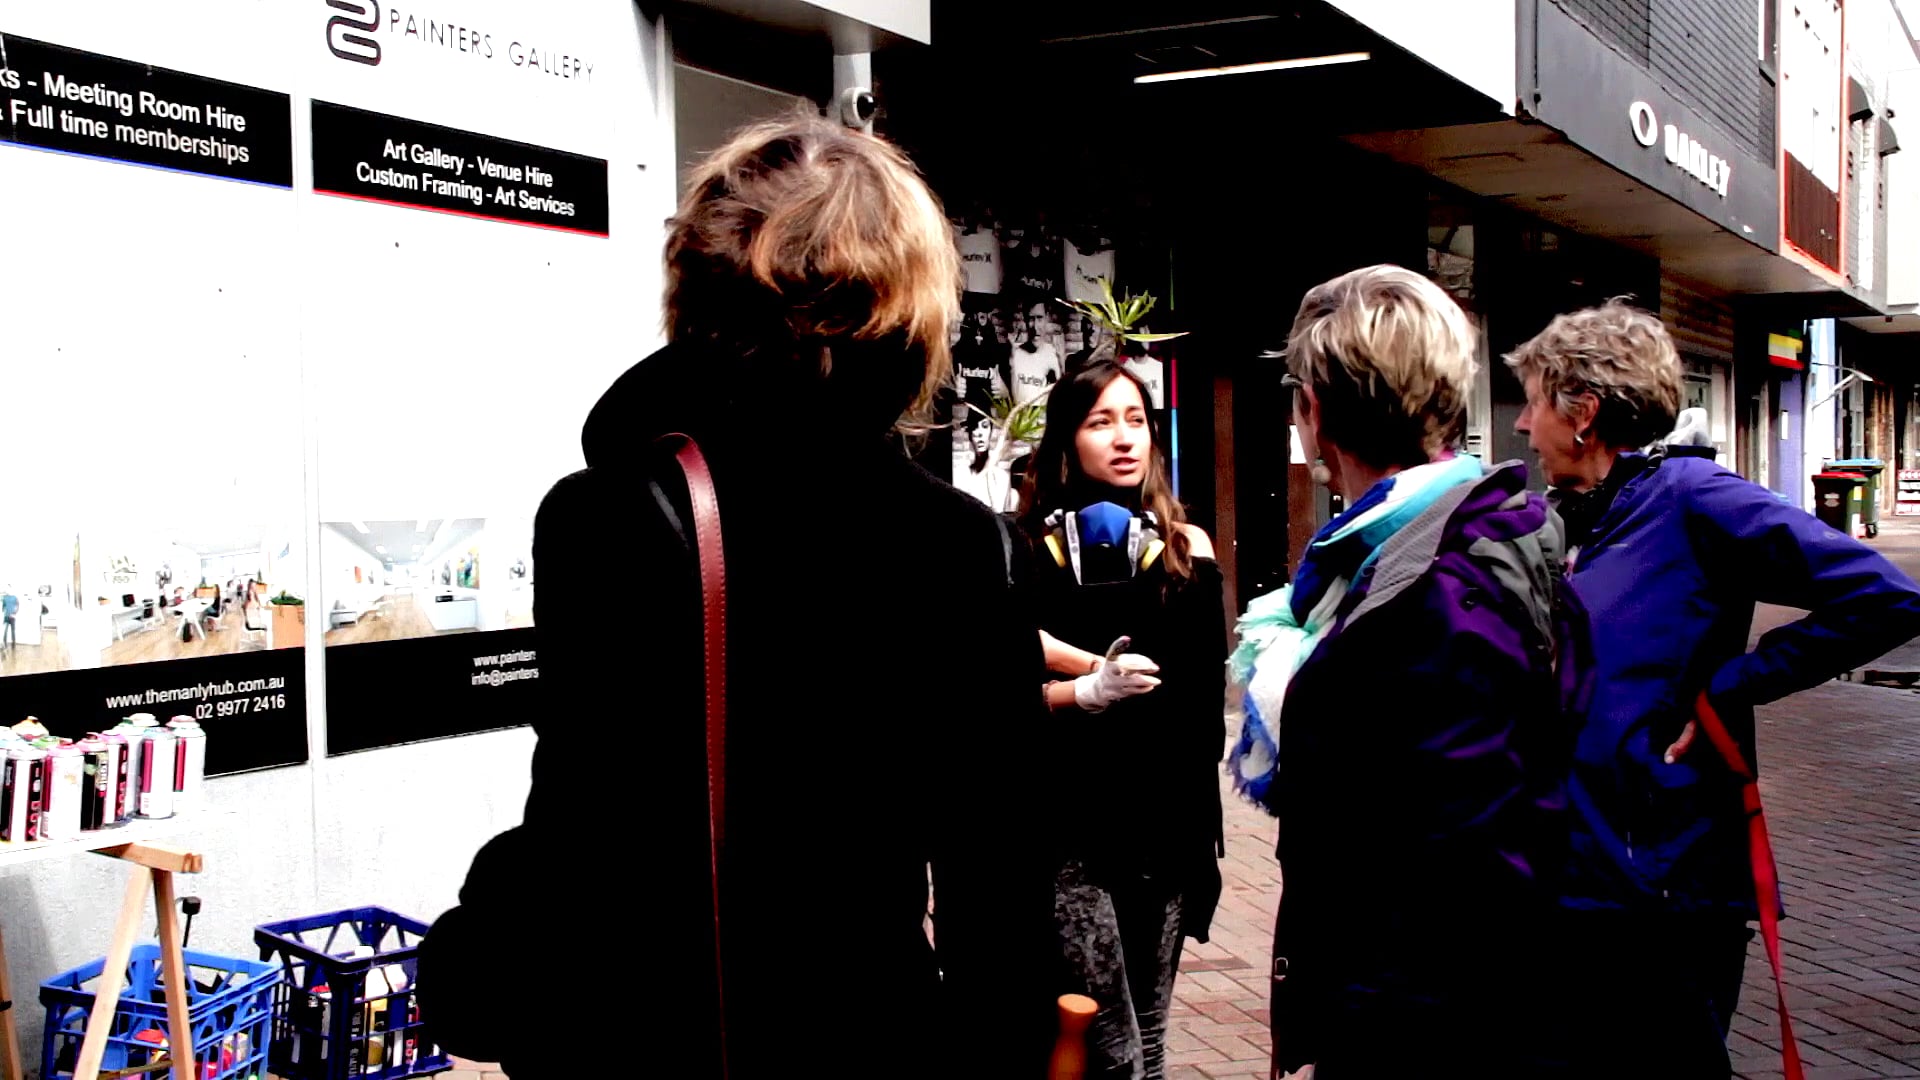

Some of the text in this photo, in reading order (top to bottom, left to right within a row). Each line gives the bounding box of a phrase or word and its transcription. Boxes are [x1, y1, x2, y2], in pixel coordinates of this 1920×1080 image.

[390, 8, 594, 84] PAINTERS GALLERY
[43, 71, 134, 117] Meeting
[139, 91, 201, 124] Room
[206, 104, 247, 132] Hire
[10, 98, 54, 130] Full
[60, 109, 109, 139] time
[115, 124, 250, 165] memberships
[383, 139, 407, 162] Art
[410, 143, 464, 176] Gallery
[476, 156, 522, 182] Venue
[525, 165, 553, 188] Hire
[356, 161, 418, 190] Custom
[422, 172, 482, 206] Framing
[494, 186, 516, 207] Art
[518, 190, 575, 217] Services
[963, 367, 989, 379] Hurley
[1018, 373, 1044, 387] Hurley
[106, 676, 286, 709] www.themanlyhub.com.au
[196, 693, 286, 720] 02 9977 2416
